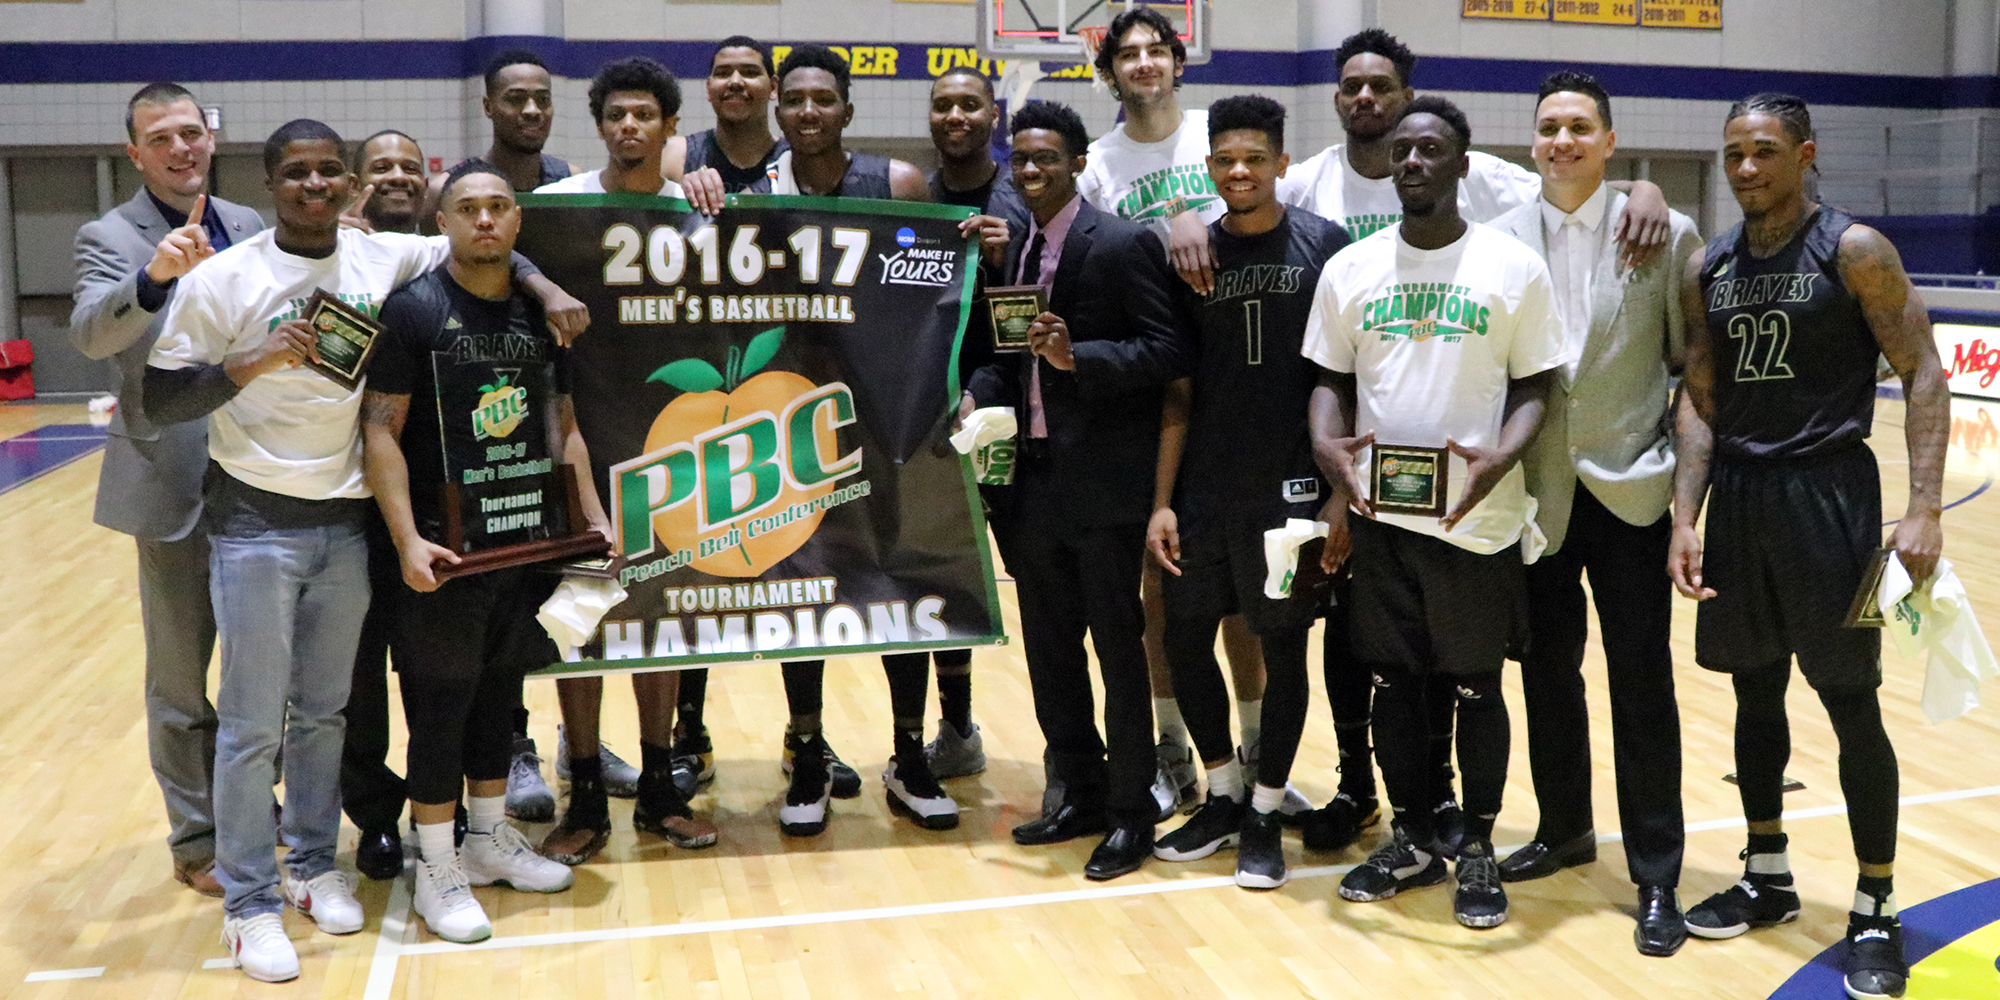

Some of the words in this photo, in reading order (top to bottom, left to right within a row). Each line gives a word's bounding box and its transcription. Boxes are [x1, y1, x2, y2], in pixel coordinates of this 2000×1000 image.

[1130, 164, 1205, 189] TOURNAMENT
[1117, 172, 1219, 221] CHAMPION
[602, 223, 870, 286] 2016-17
[878, 250, 955, 285] YOURS
[907, 248, 942, 261] MAKE
[943, 251, 956, 261] IT
[619, 287, 703, 324] MEN'S
[708, 294, 856, 323] BASKETBALL
[1385, 282, 1472, 296] TOURNAMENT
[1709, 273, 1820, 312] BRAVES
[1243, 299, 1262, 365] 1
[1362, 292, 1491, 336] CHAMPIONS
[1728, 309, 1795, 383] 22
[471, 386, 528, 437] PBC
[485, 441, 527, 462] 2016-17
[462, 466, 496, 485] Men's
[497, 457, 552, 480] Basketball
[609, 381, 863, 562] PBC
[480, 488, 543, 513] Tournament
[486, 510, 542, 534] CHAMPION
[619, 549, 693, 589] Peach
[699, 528, 742, 560] Belt
[746, 480, 872, 540] Conference
[663, 577, 837, 614] TOURNAMENT
[563, 596, 951, 664] HAMPIONS
